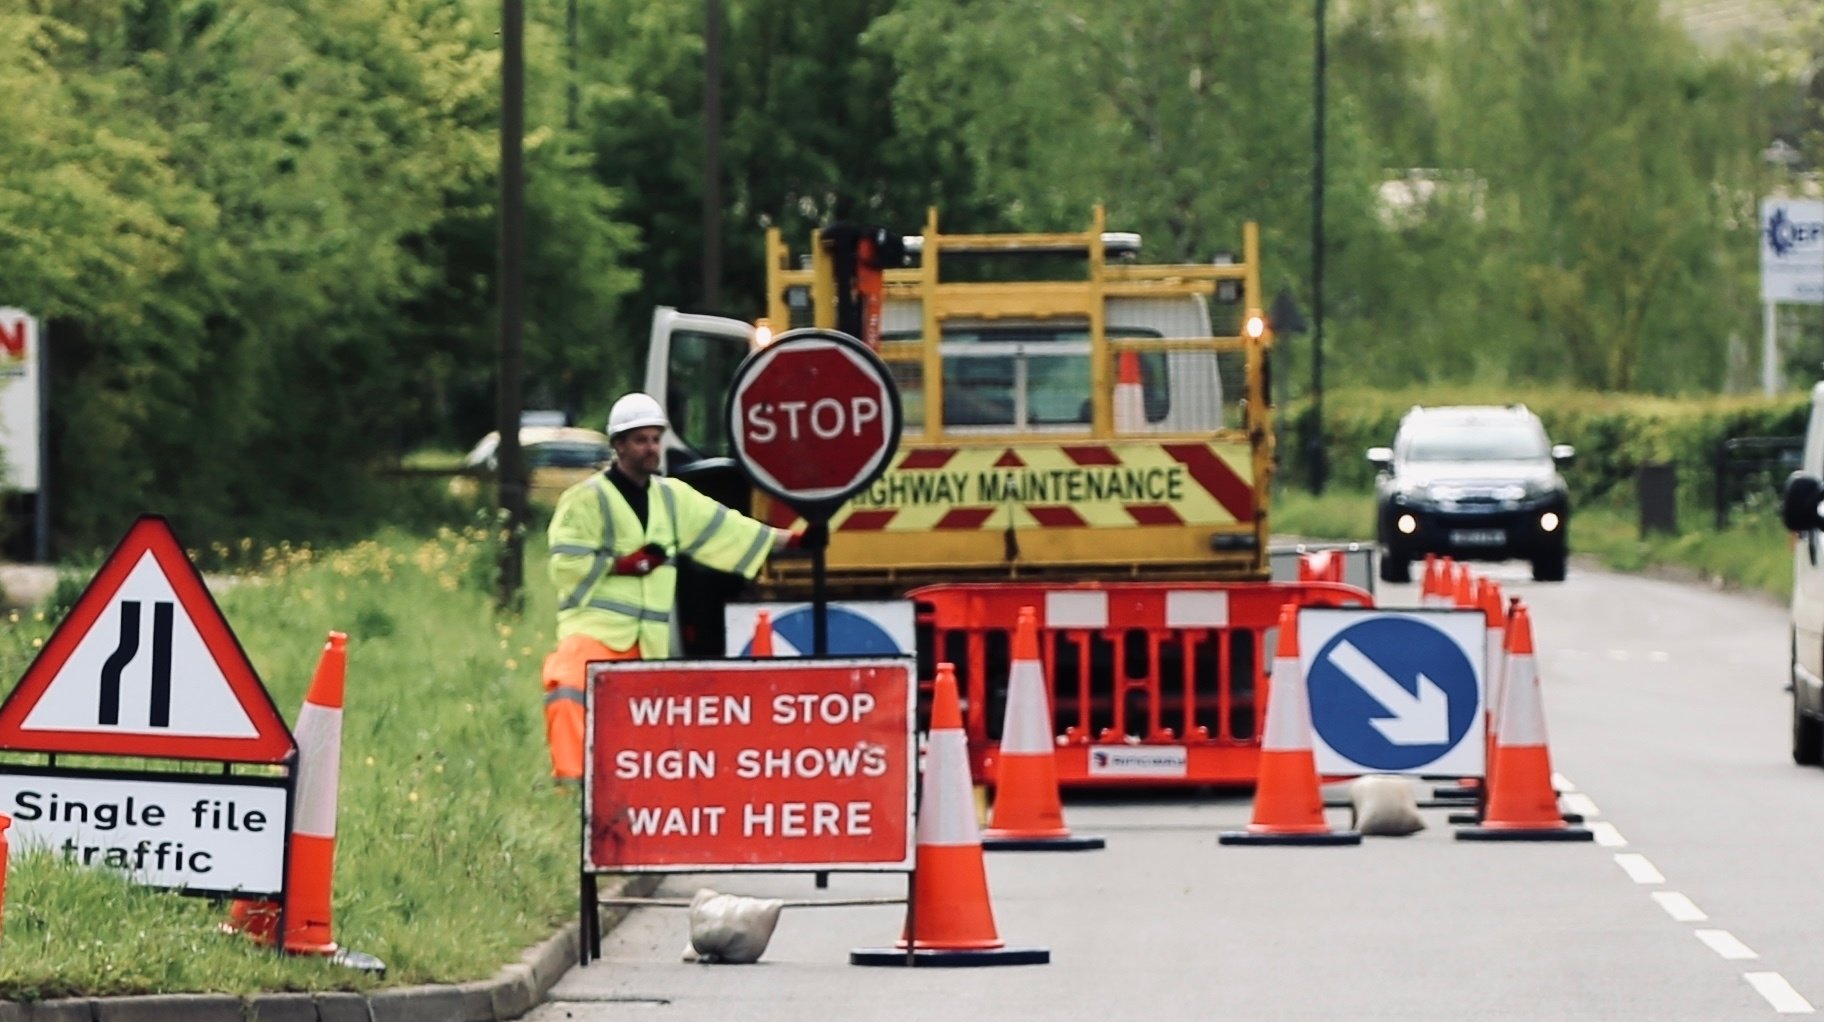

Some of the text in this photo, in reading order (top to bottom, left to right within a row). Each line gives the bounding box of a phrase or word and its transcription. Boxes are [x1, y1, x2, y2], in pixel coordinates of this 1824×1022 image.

[747, 395, 879, 443] STOP
[852, 467, 1184, 506] GHWAY MAINTENANCE
[628, 693, 876, 727] WHEN STOP
[614, 746, 888, 780] SIGN SHOWS
[12, 790, 268, 833] Single file
[627, 802, 874, 837] WAIT HERE
[60, 838, 213, 873] traffic
